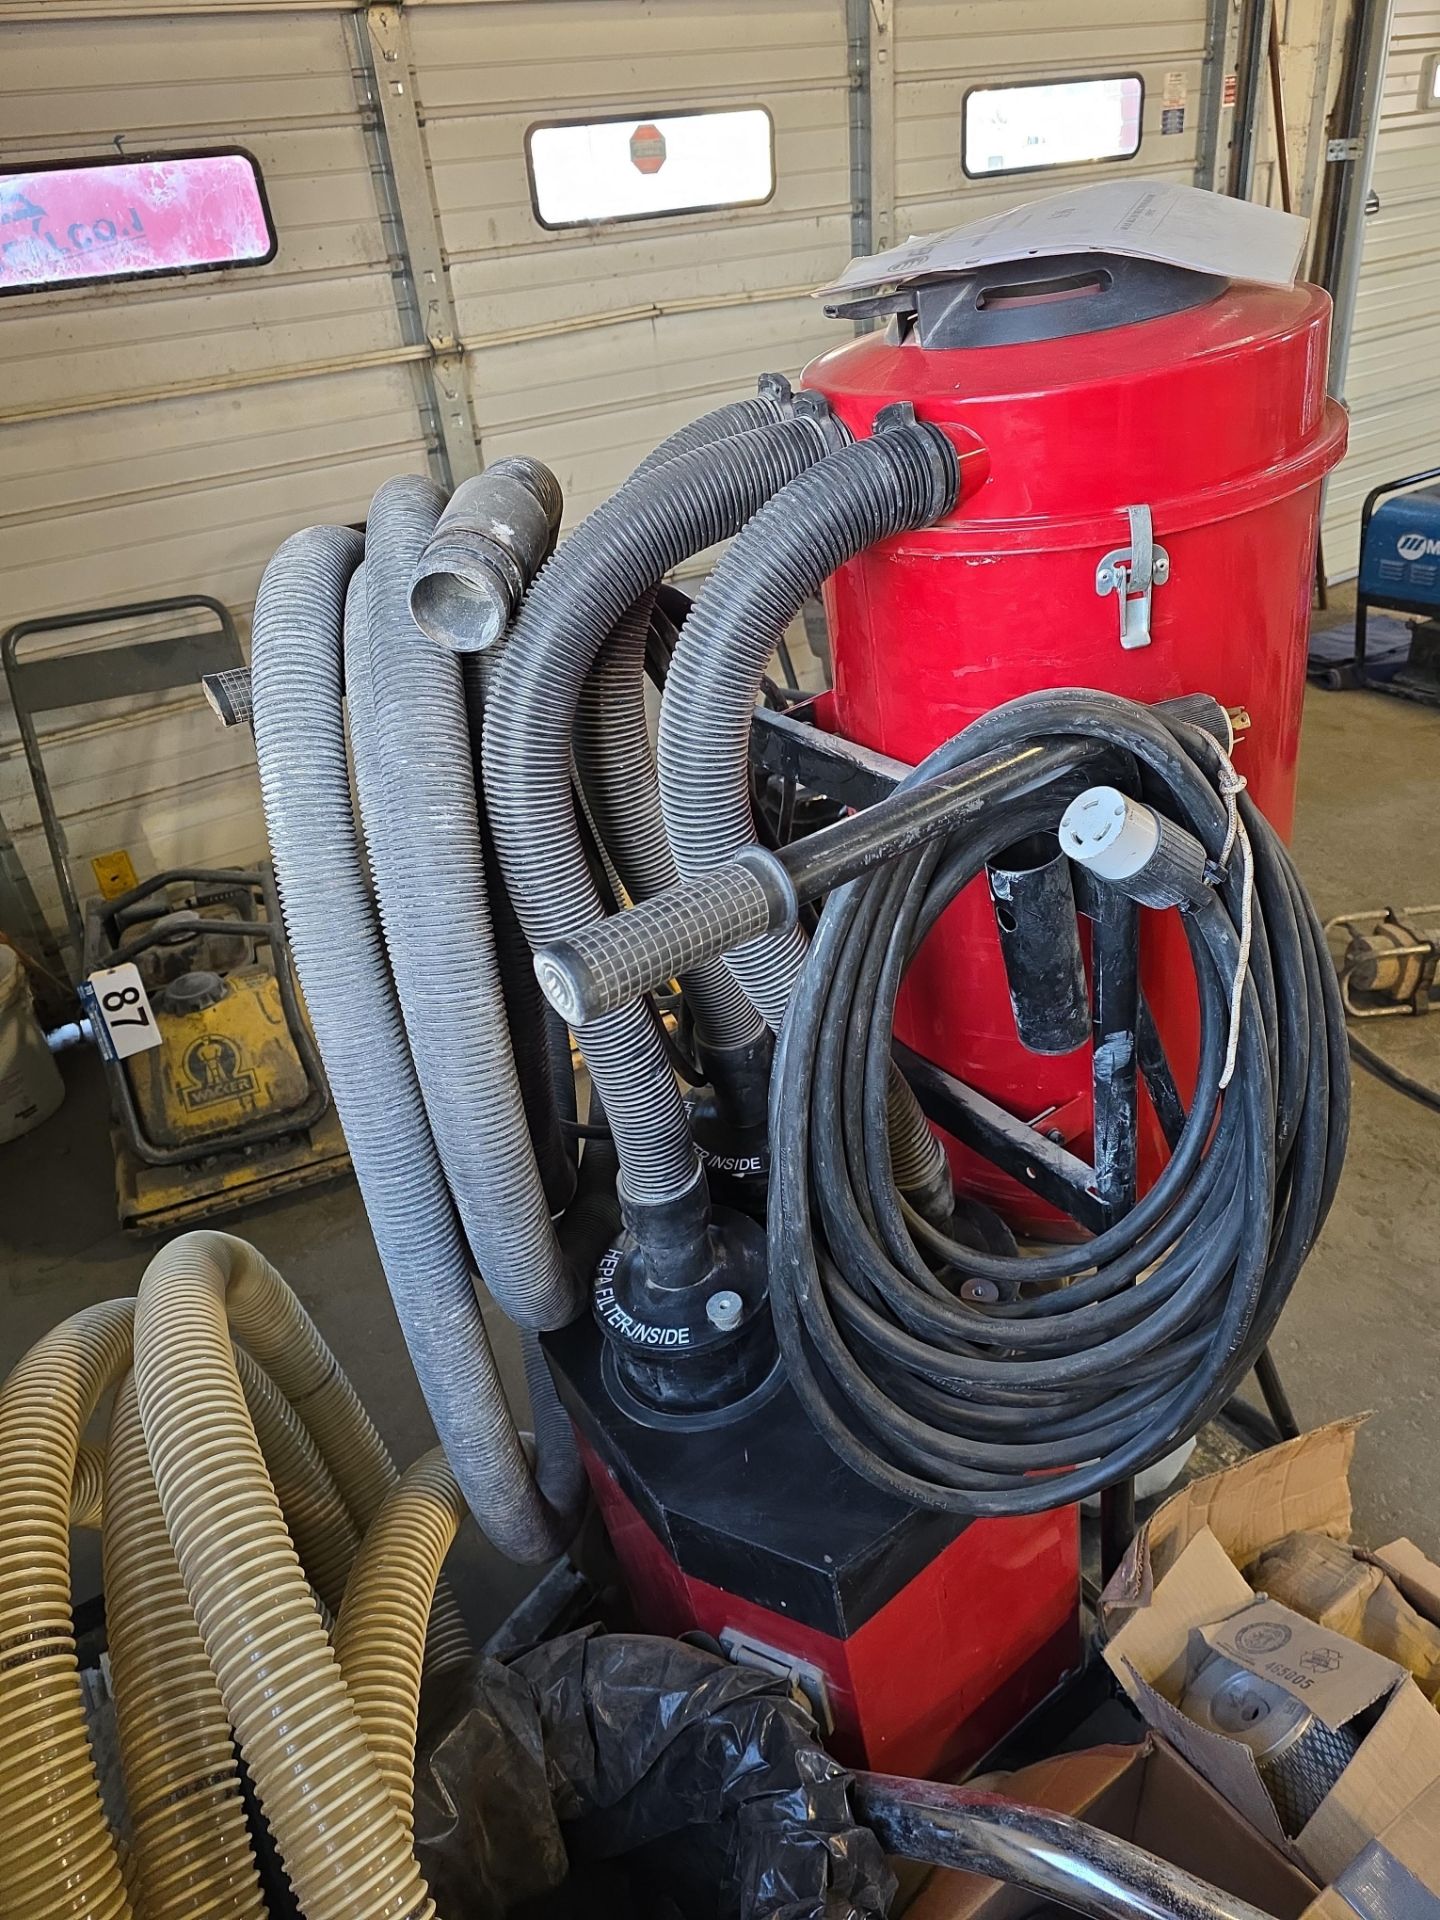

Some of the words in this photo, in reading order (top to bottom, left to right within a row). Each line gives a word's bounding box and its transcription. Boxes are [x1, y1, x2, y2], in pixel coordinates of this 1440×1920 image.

[102, 985, 150, 1029] 87
[191, 1078, 251, 1103] WACKER
[707, 1155, 762, 1171] INSIDE
[597, 1248, 624, 1285] HEPA
[595, 1288, 633, 1334] FILTER
[628, 1322, 691, 1346] INSIDE
[1264, 1661, 1315, 1690] 465005
